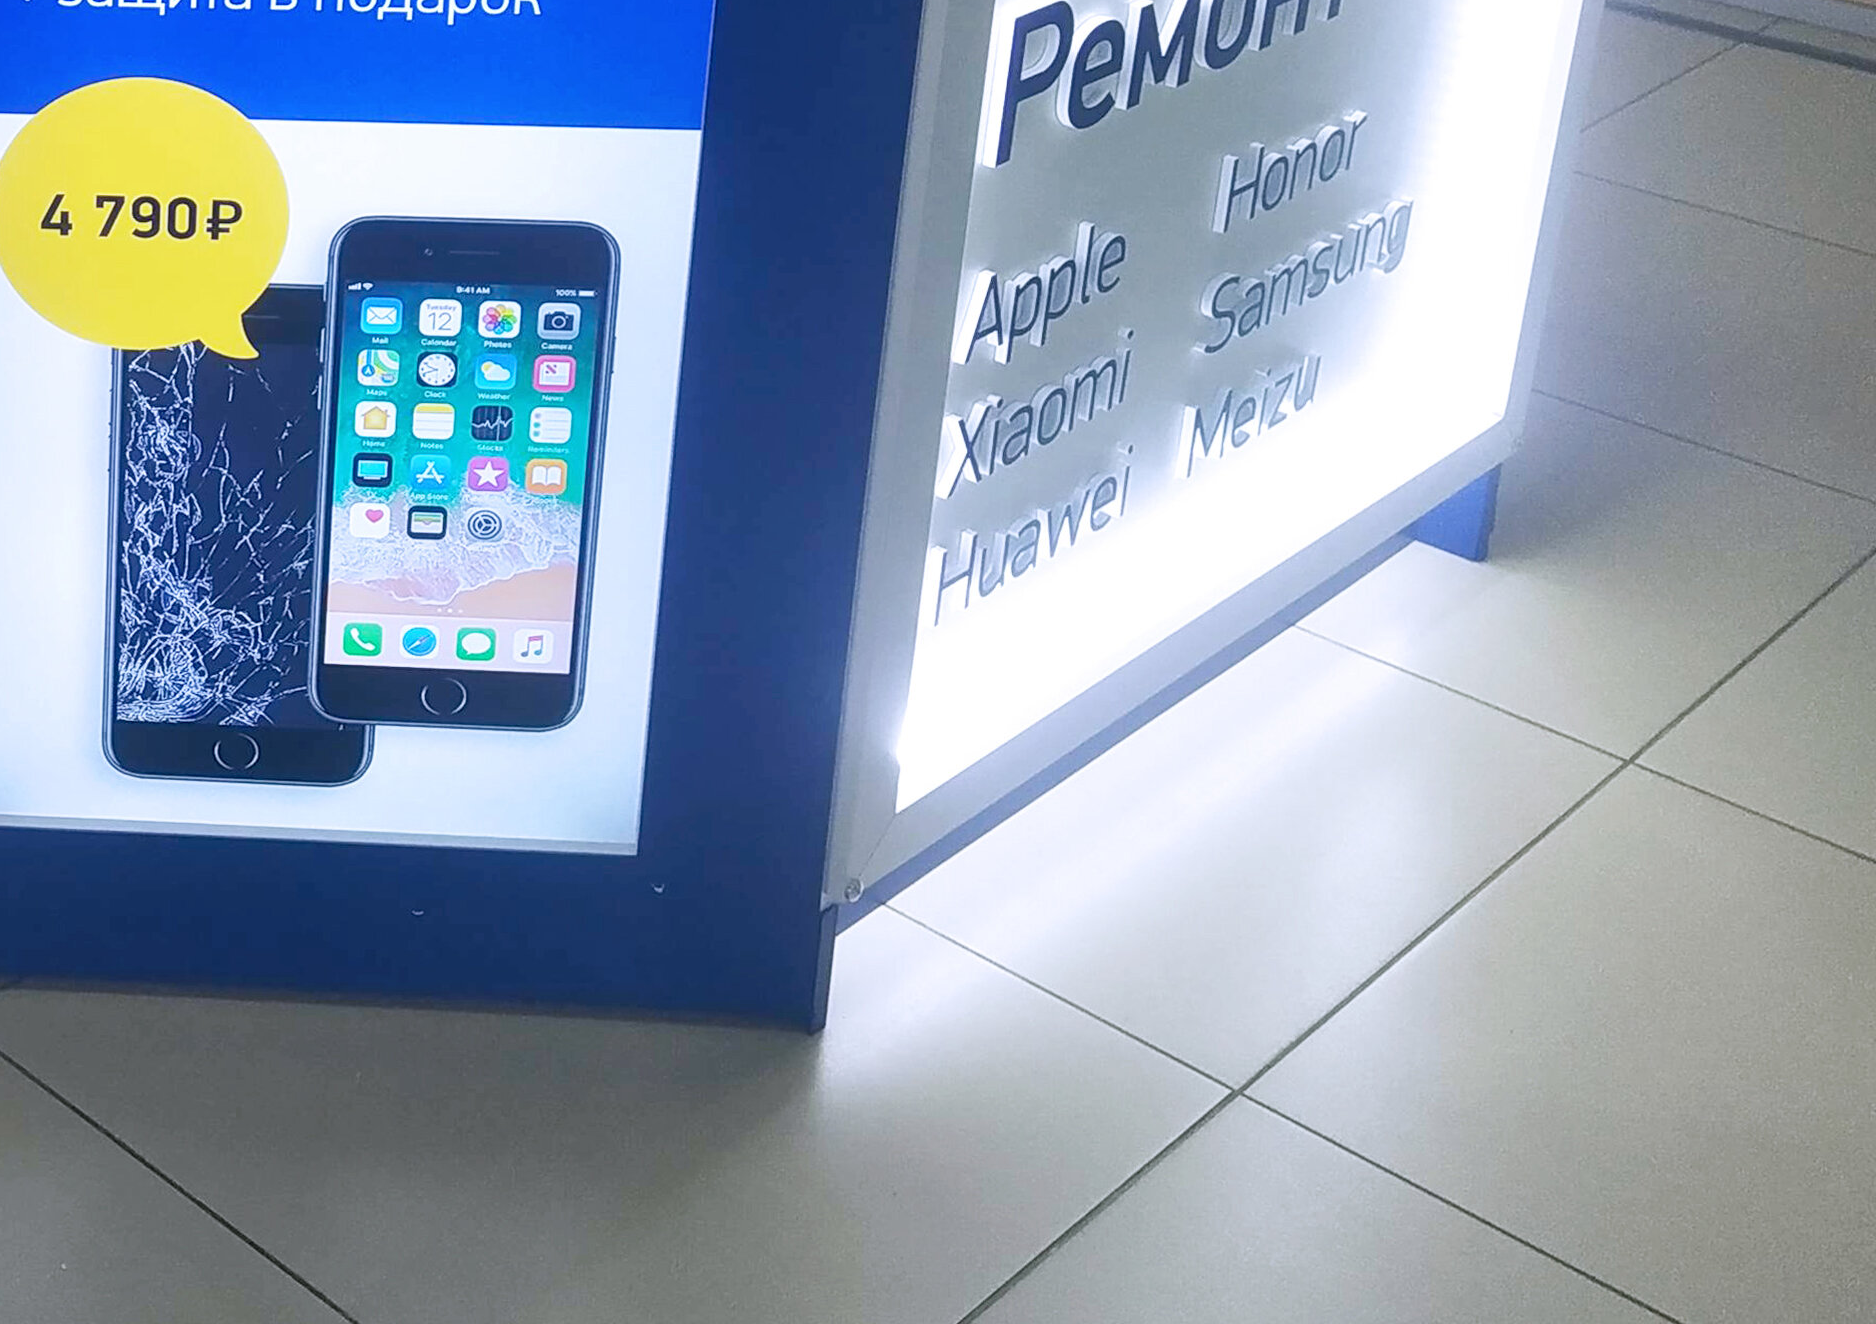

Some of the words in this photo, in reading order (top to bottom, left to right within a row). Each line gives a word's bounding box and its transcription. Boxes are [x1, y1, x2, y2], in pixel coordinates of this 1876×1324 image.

[1216, 112, 1367, 233] Honor
[40, 194, 73, 236] 4
[95, 194, 243, 241] 790₽
[1194, 198, 1414, 354] Samsung
[476, 286, 491, 295] AM
[555, 289, 577, 297] 100%
[954, 222, 1126, 364] Apple
[426, 303, 457, 313] Tuesday
[428, 312, 453, 332] 12
[372, 336, 389, 345] Mail
[483, 340, 512, 349] Photos
[540, 342, 573, 351] Camera
[366, 388, 388, 398] Maps
[424, 390, 447, 398] Clock
[477, 392, 511, 401] Weather
[541, 394, 564, 402] News
[938, 328, 1134, 499] Xiaomi
[1178, 354, 1322, 478] Meizu
[420, 441, 444, 450] Notes
[410, 491, 426, 502] App
[426, 492, 449, 501] Store
[931, 445, 1133, 627] Huawei
